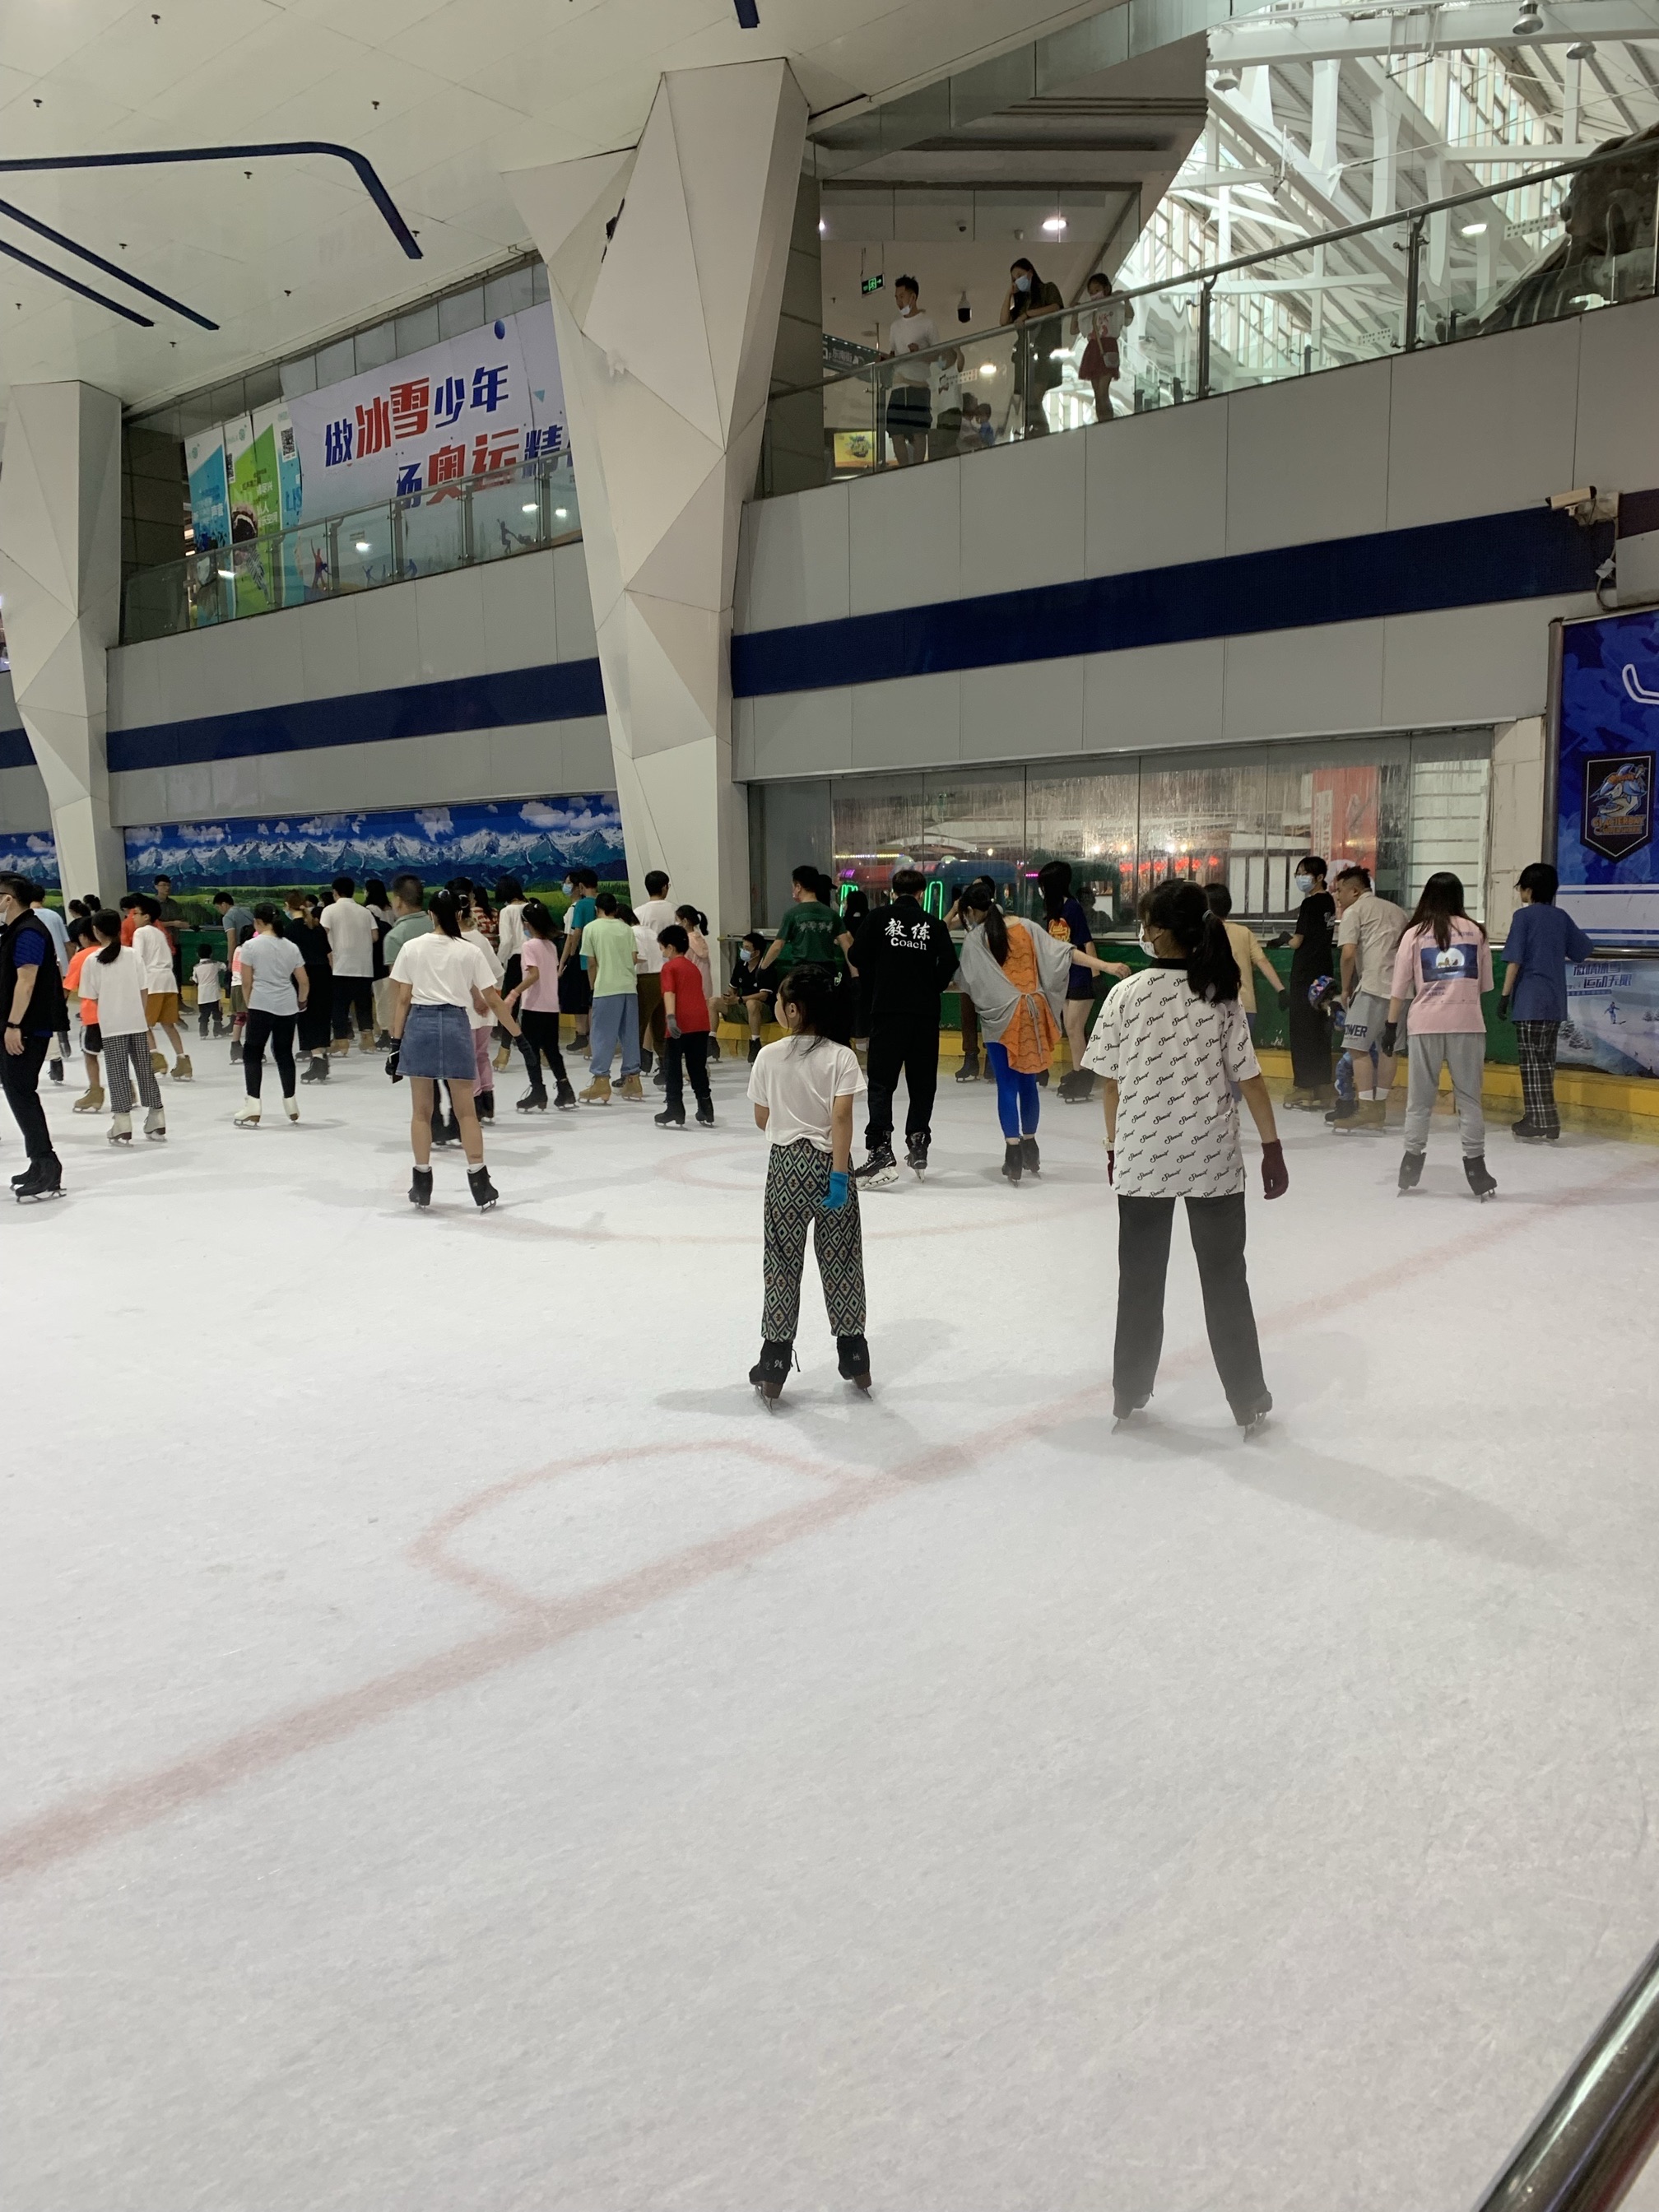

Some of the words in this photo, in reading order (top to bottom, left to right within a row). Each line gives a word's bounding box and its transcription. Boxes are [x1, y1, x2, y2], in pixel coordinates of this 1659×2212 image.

[324, 365, 509, 467] 做冰雪少年
[396, 424, 573, 509] 扬奥运精
[885, 918, 931, 941] 教练
[890, 937, 927, 950] Coach
